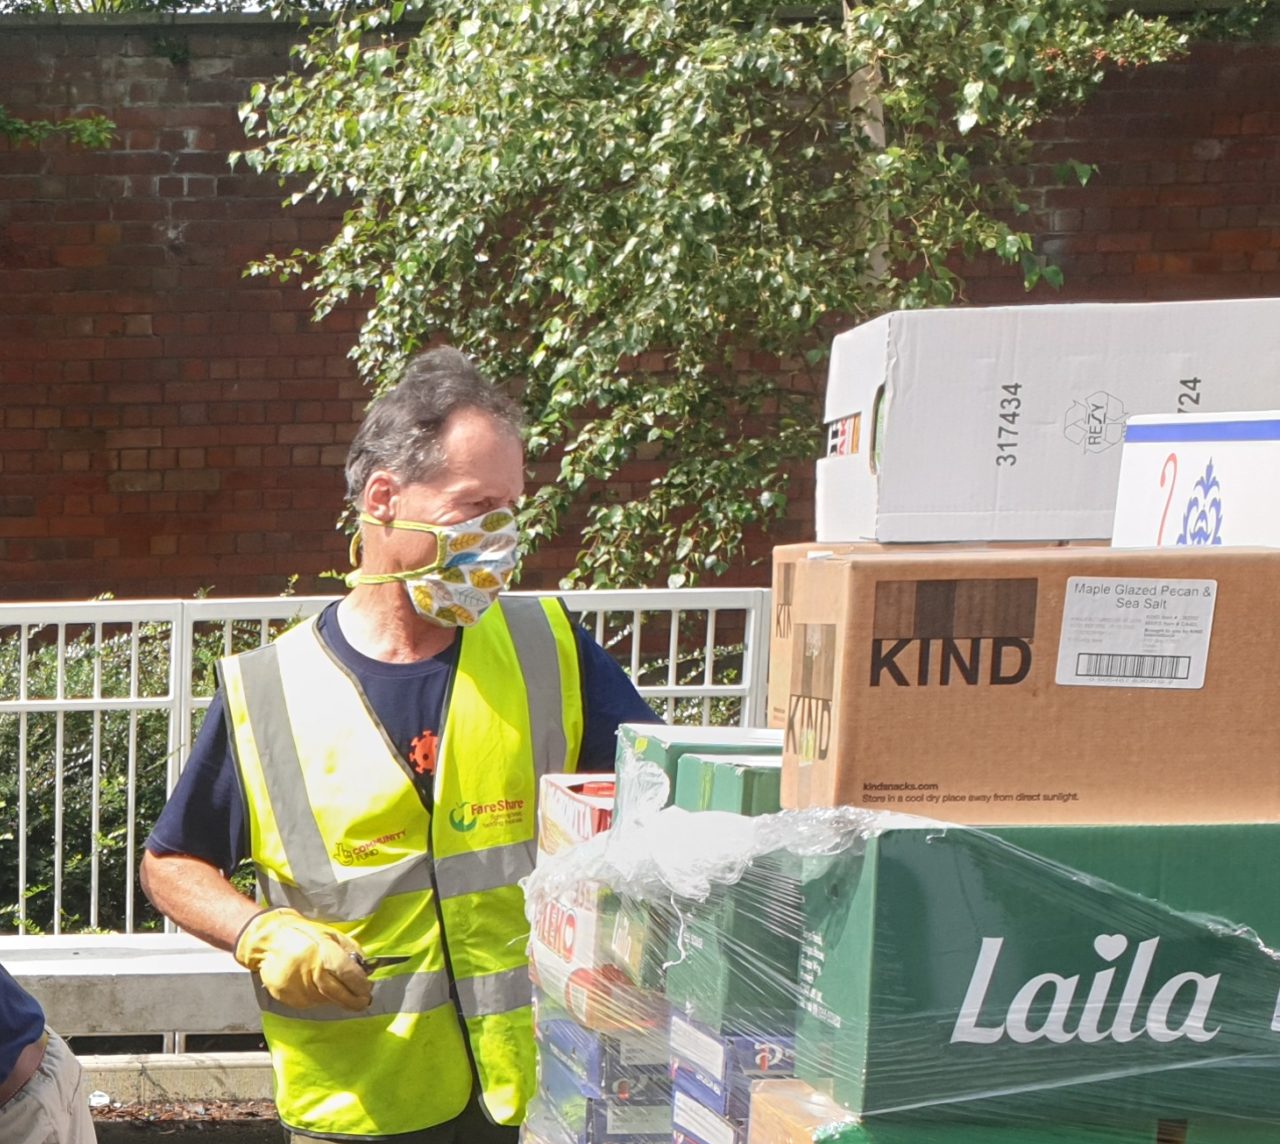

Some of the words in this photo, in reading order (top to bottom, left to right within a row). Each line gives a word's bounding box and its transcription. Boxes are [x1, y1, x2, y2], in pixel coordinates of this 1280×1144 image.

[996, 382, 1022, 467] 317434
[1088, 402, 1106, 446] RESY
[1074, 583, 1110, 596] Maple
[1115, 584, 1157, 597] Glazed
[1161, 585, 1198, 598] Pecan
[1202, 586, 1211, 597] &
[1116, 598, 1140, 609] Sea
[1144, 598, 1167, 610] Salt
[870, 636, 1032, 687] KIND
[786, 694, 832, 760] KIND
[862, 794, 885, 803] Store
[888, 794, 896, 802] in
[906, 794, 923, 802] cool
[926, 794, 939, 804] dry
[942, 793, 966, 804] place
[969, 794, 991, 804] away
[993, 792, 1014, 801] from
[1016, 792, 1041, 801] direct
[1043, 792, 1079, 803] sunlight.
[863, 783, 938, 791] kindsnacks.com
[352, 830, 406, 855] COMMUNITY
[950, 934, 1221, 1044] Laila
